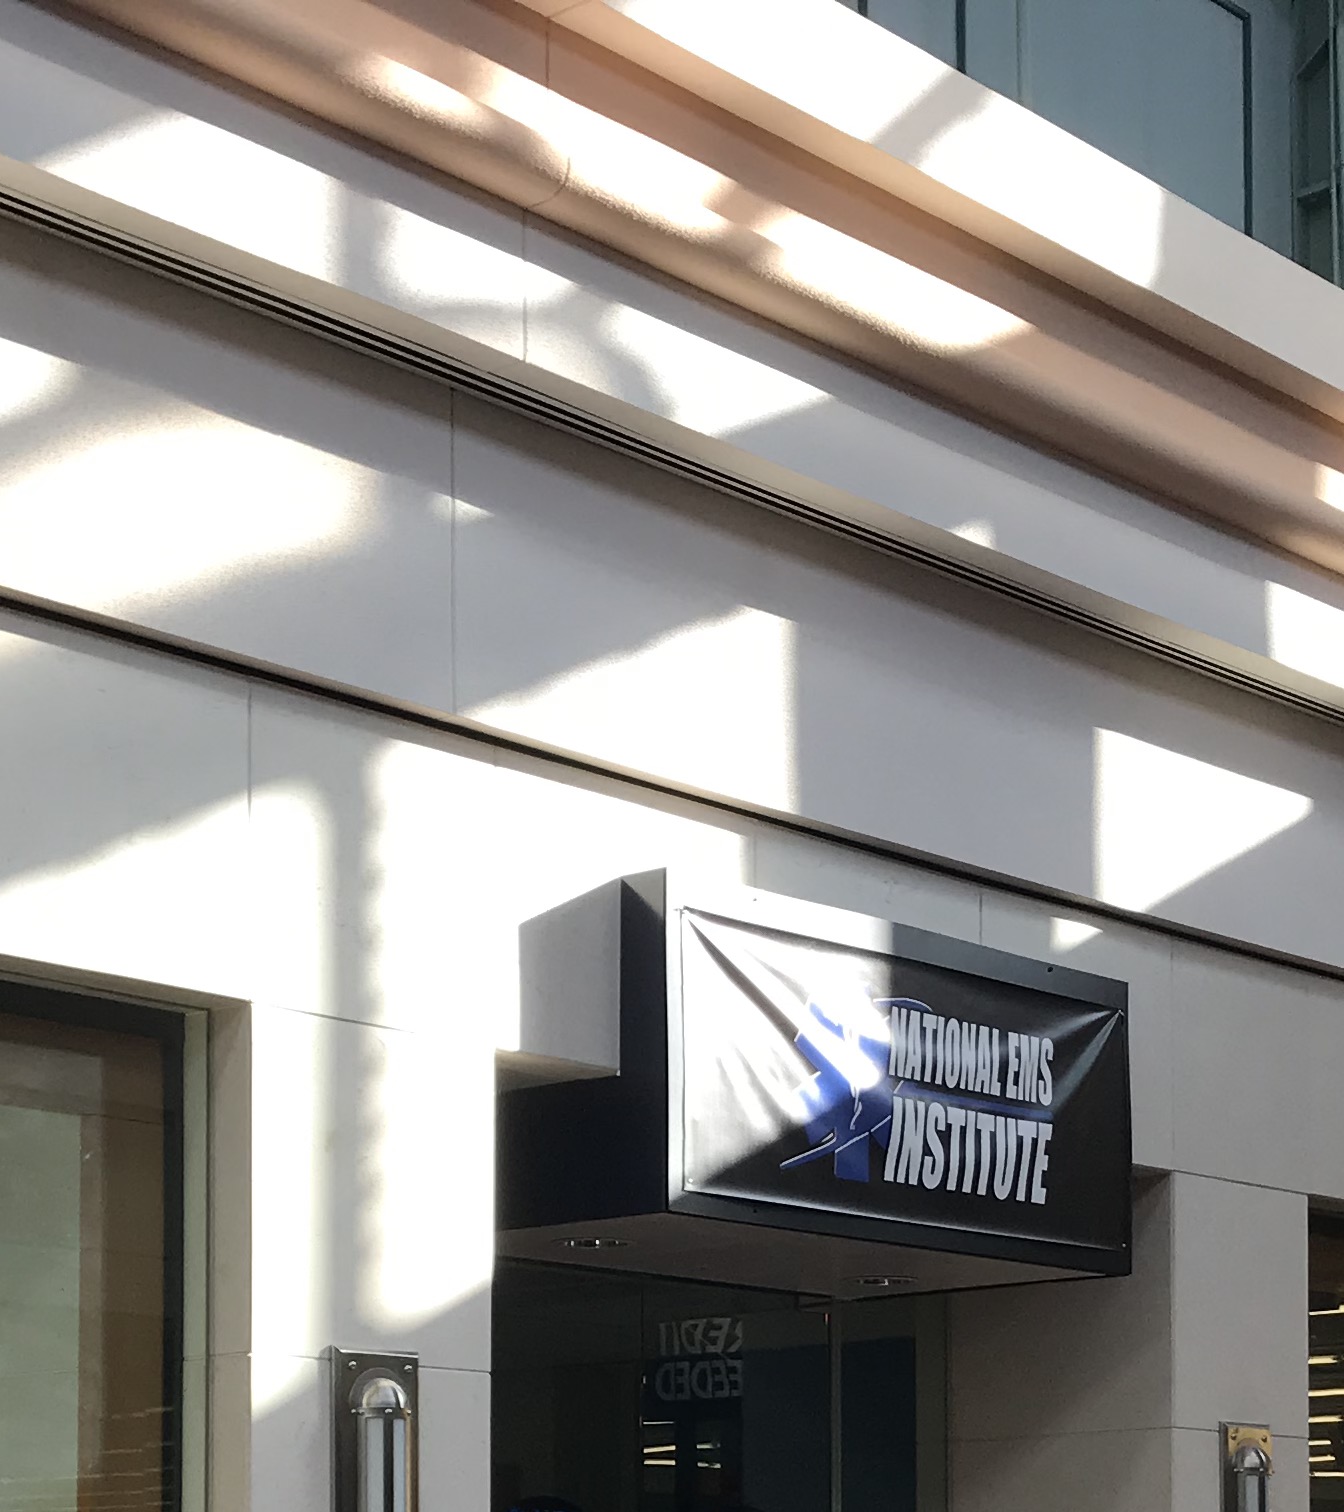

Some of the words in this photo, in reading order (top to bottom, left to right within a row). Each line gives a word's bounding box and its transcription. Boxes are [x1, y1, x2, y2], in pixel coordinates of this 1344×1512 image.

[889, 1006, 1001, 1096] NATIONAL
[1006, 1032, 1054, 1106] EMS
[884, 1096, 1053, 1205] INSTITUTE
